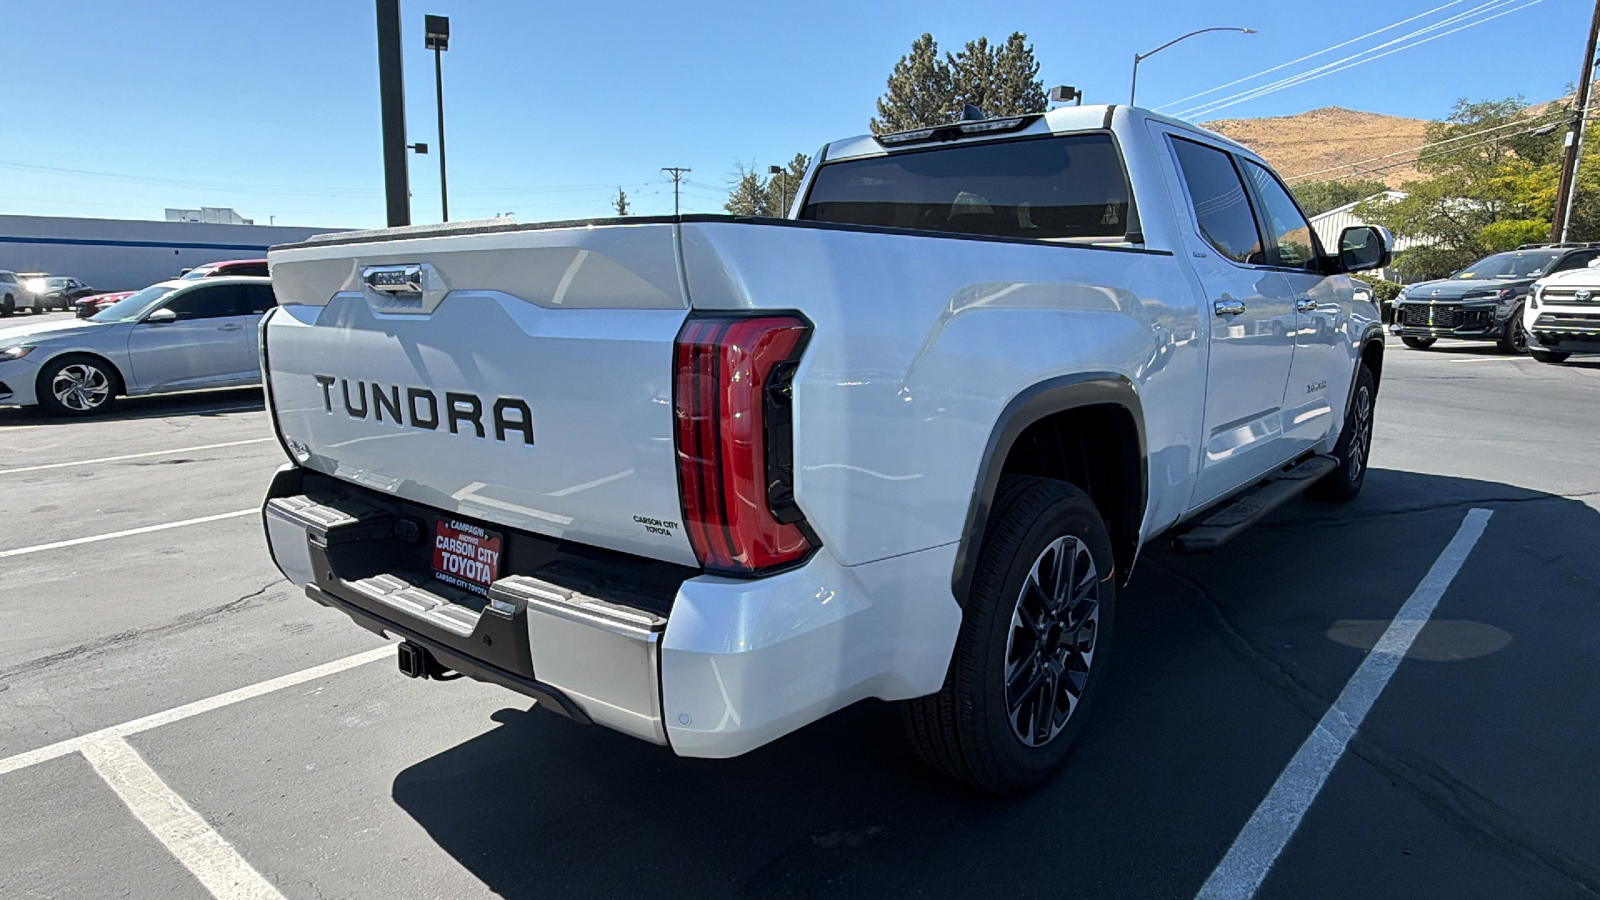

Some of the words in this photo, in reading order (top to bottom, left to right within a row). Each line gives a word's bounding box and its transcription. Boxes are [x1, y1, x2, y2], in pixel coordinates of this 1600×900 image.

[313, 374, 535, 447] TUNDRA
[633, 515, 662, 527] CARSON
[663, 521, 678, 529] CITY
[645, 525, 672, 537] TOYOTA
[436, 535, 476, 558] CARSON
[477, 547, 499, 565] CITY
[442, 551, 491, 585] TOYOTA
[435, 572, 456, 584] CARSON
[457, 579, 468, 588] CITY
[468, 584, 488, 595] TOYOTA
